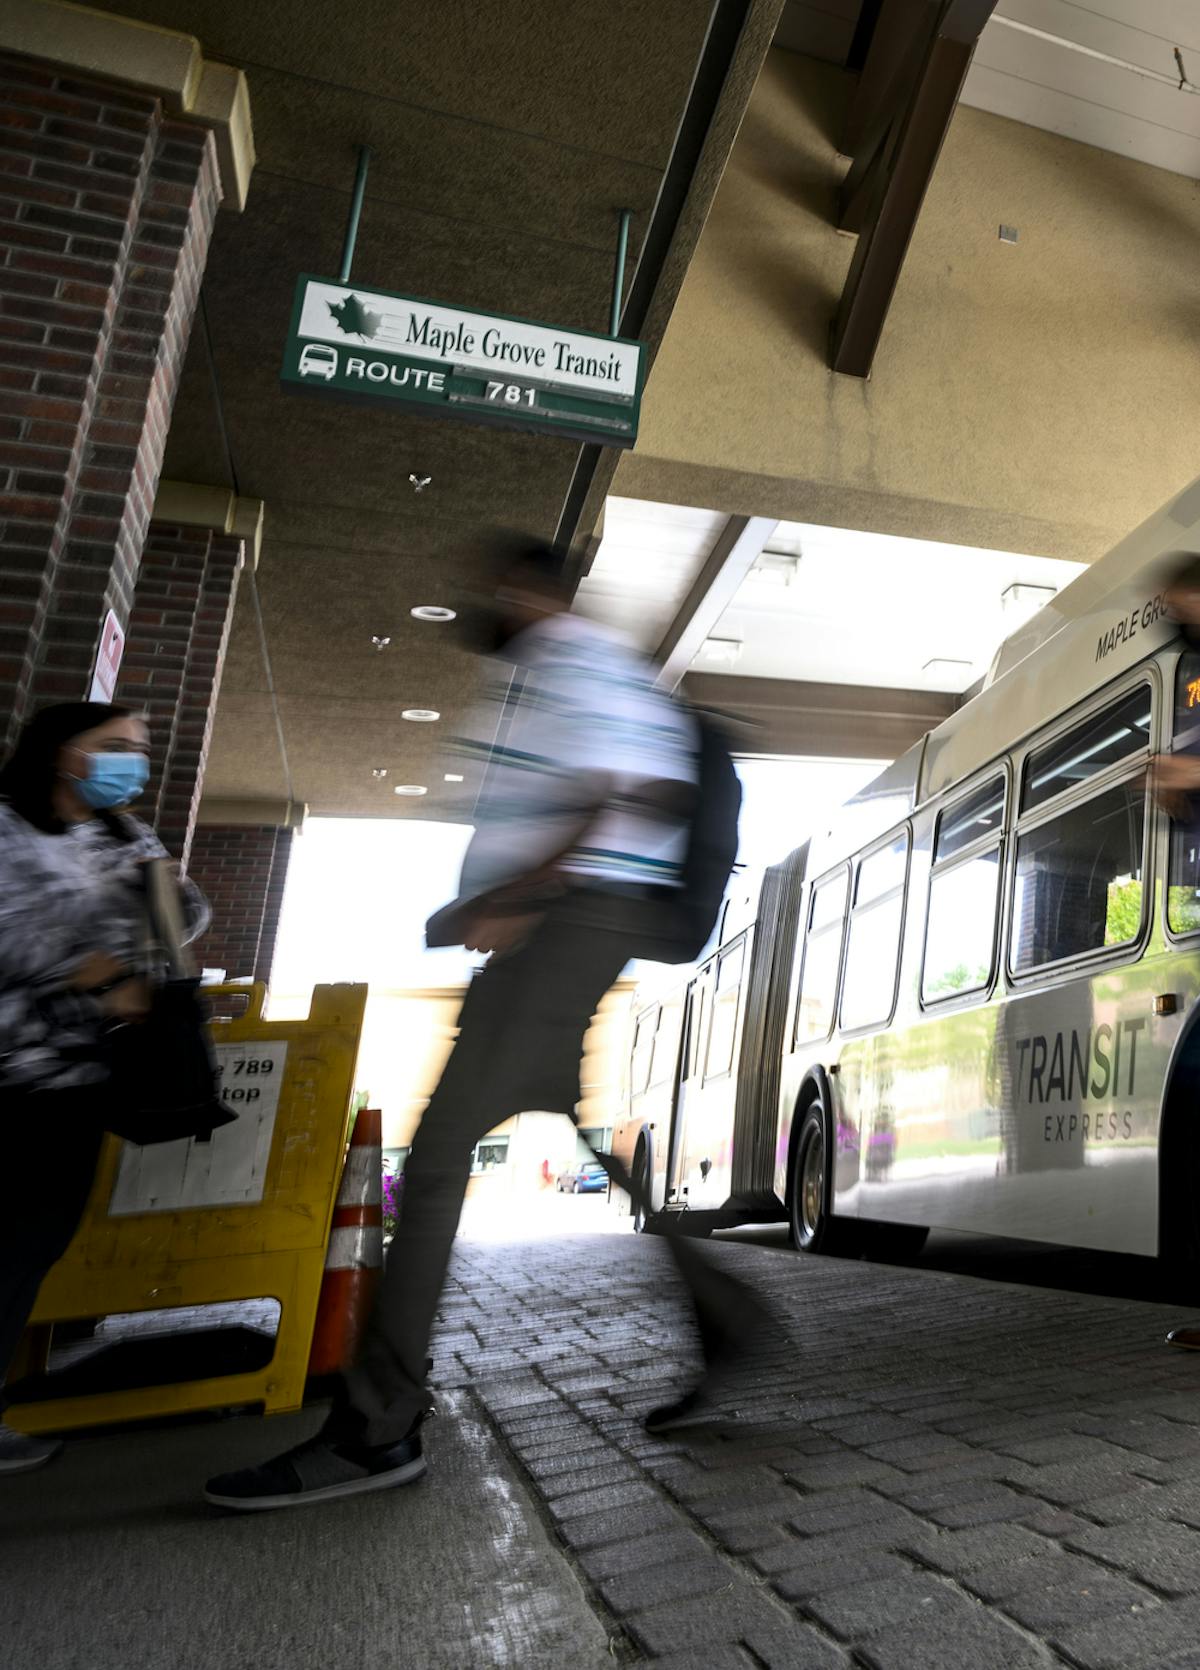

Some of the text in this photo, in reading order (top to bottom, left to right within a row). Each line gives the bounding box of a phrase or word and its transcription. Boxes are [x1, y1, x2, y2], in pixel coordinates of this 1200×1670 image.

[405, 312, 623, 383] Maple Grove Transit
[345, 356, 537, 408] ROUTE 781
[1095, 609, 1140, 663] MAPLE
[233, 1059, 274, 1075] 789
[1015, 1017, 1146, 1104] TRANSIT
[216, 1086, 261, 1105] top
[1043, 1111, 1133, 1142] EXPRESS
